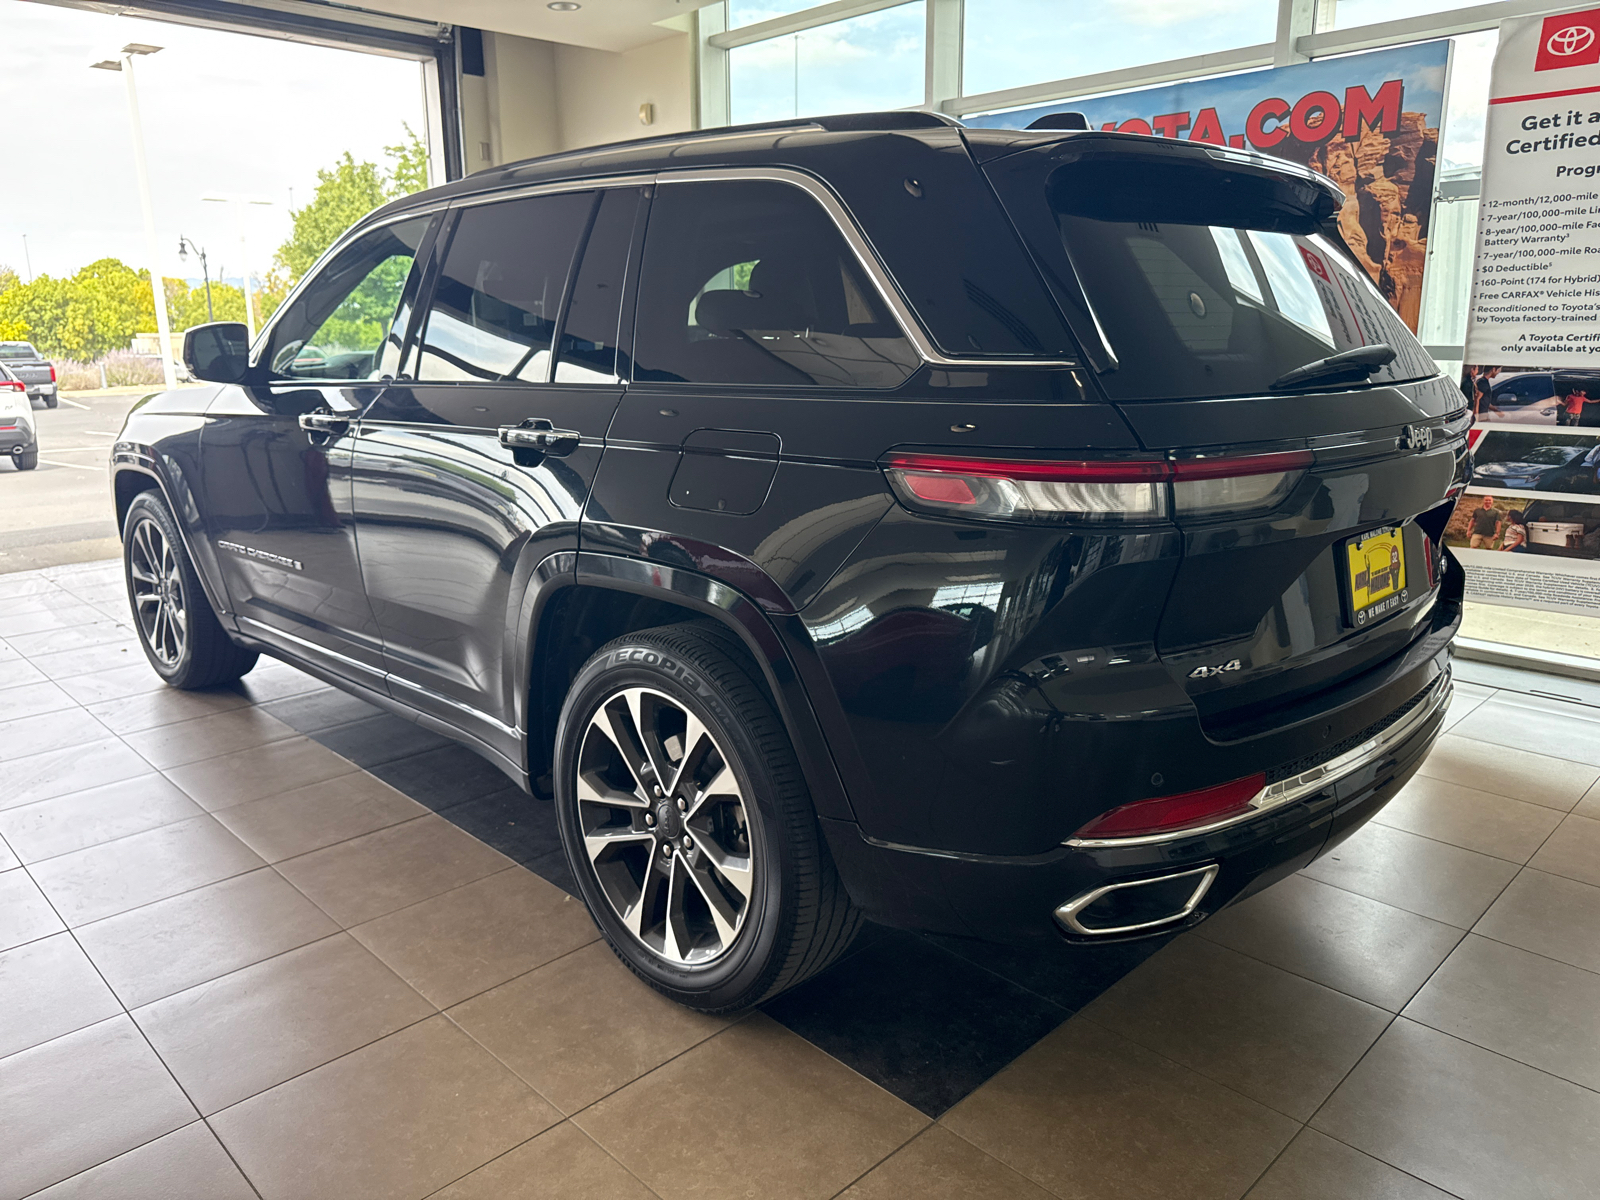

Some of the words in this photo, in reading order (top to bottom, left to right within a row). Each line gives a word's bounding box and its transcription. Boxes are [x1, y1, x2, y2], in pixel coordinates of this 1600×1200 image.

[1521, 113, 1561, 131] Get
[1566, 110, 1583, 126] it
[1506, 129, 1600, 155] Certified
[1488, 191, 1599, 208] 12-month/12,000-mile
[1487, 207, 1587, 223] 7-year/100,000-mile
[1589, 206, 1600, 214] Li
[1485, 222, 1584, 237] 8-year/100,000-mile
[1484, 237, 1519, 246] Battery
[1483, 246, 1582, 261] 7-year/100,000-mile
[1481, 265, 1494, 273] $0
[1480, 277, 1525, 287] 160-Point
[1526, 276, 1546, 286] (174
[1548, 275, 1562, 284] for
[1563, 274, 1600, 285] Hybrid)
[1479, 292, 1499, 300] Free
[1546, 289, 1582, 298] Vehicle
[1477, 303, 1547, 313] Reconditioned
[1476, 315, 1488, 324] by
[1489, 315, 1521, 324] Toyota
[1522, 313, 1597, 324] factory-trained
[1518, 333, 1526, 341] A
[1529, 333, 1564, 343] Toyota
[1500, 344, 1523, 354] only
[1525, 343, 1574, 352] available
[1407, 425, 1433, 450] Jeep
[1391, 551, 1398, 564] 32
[1188, 659, 1241, 678] 4x4
